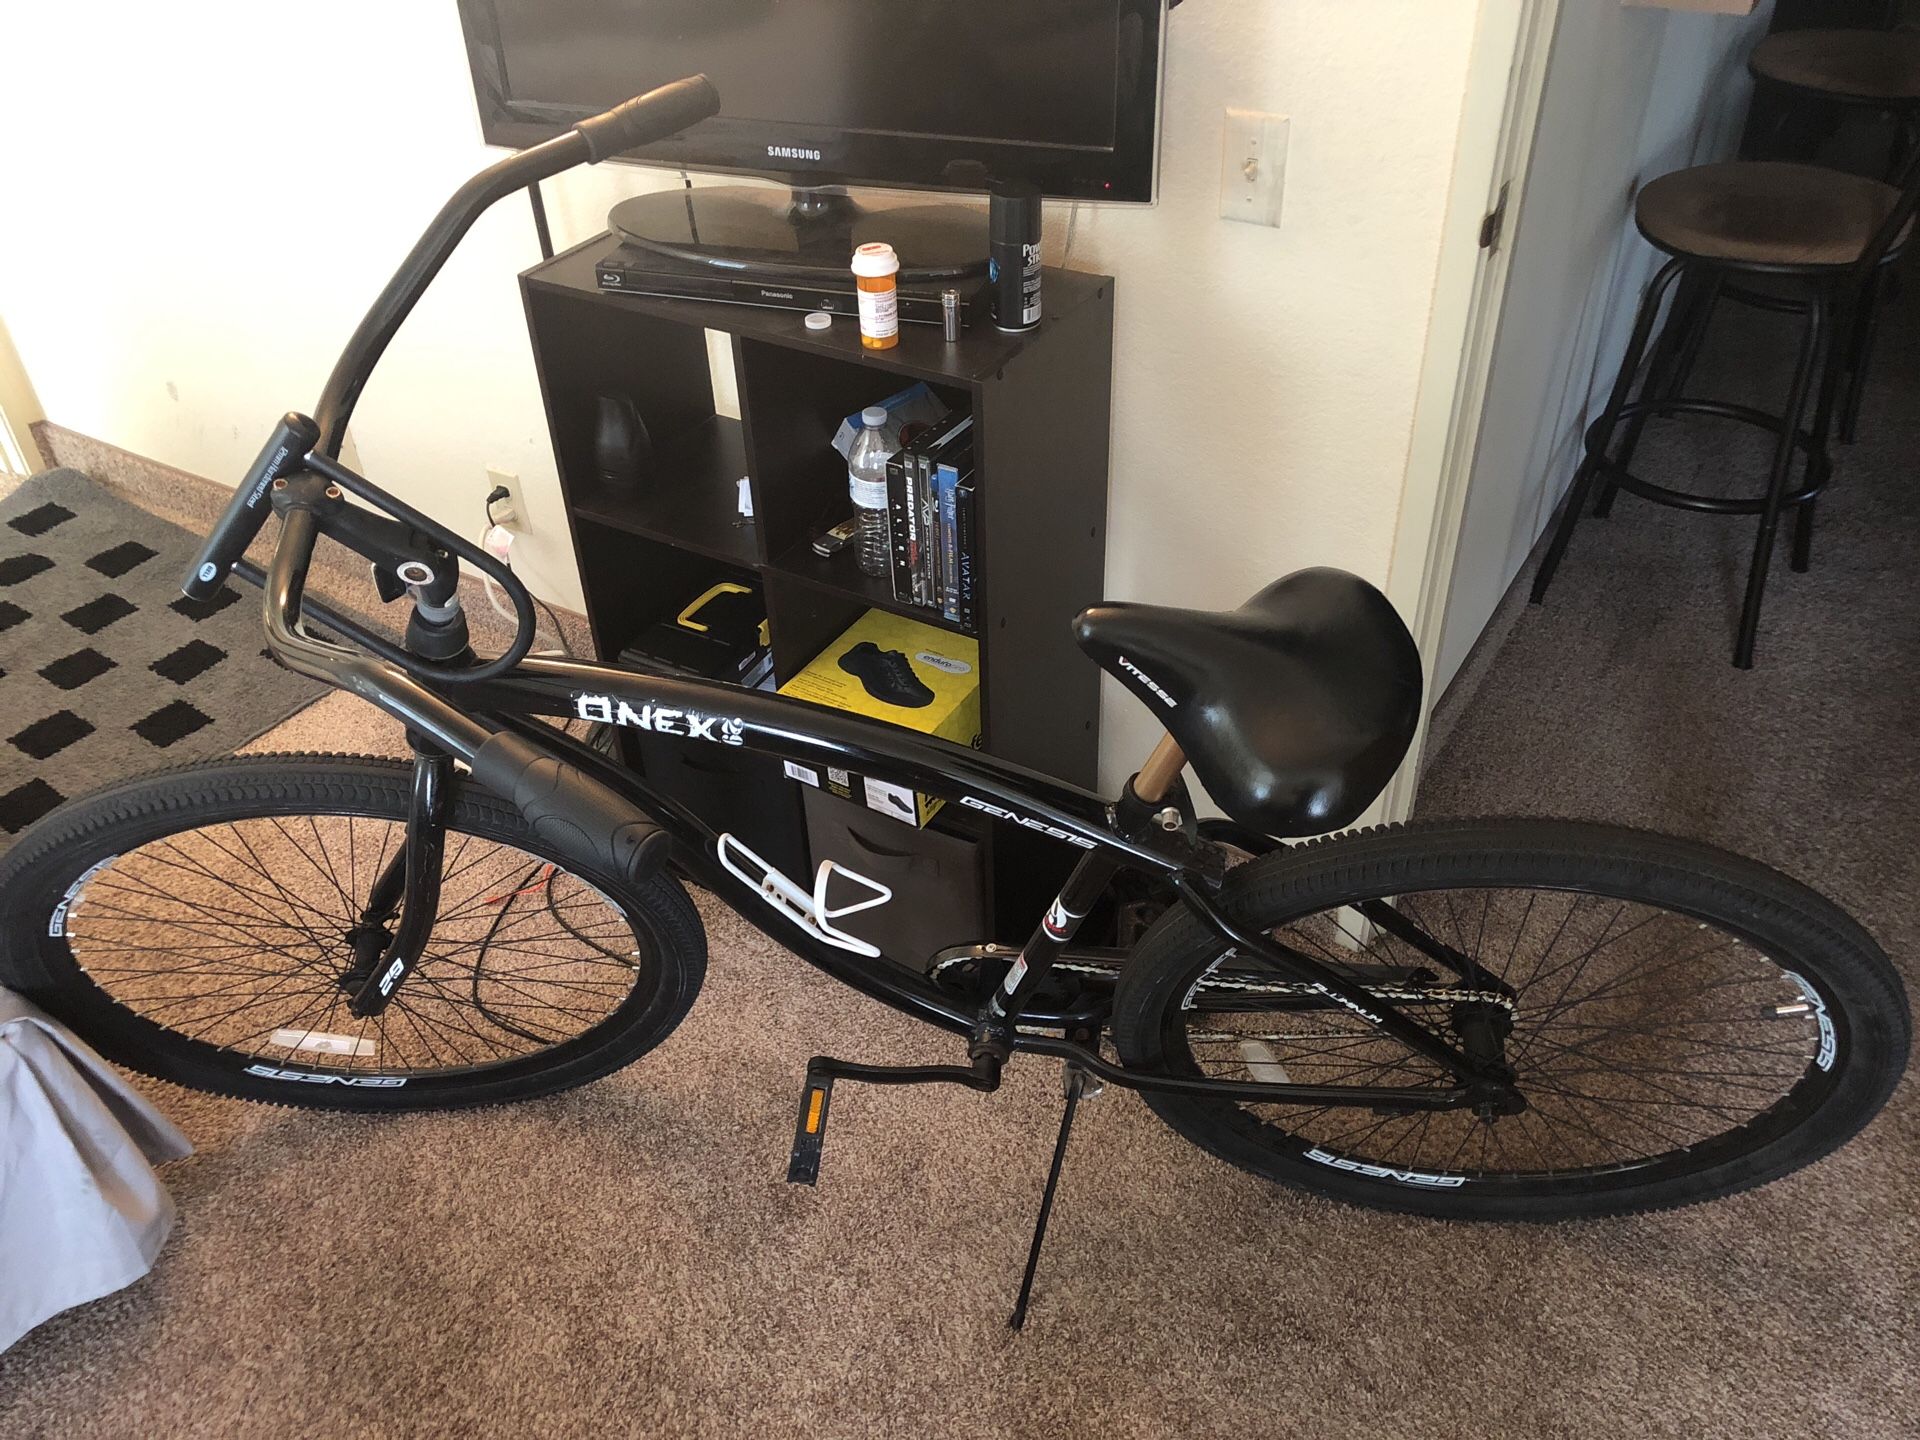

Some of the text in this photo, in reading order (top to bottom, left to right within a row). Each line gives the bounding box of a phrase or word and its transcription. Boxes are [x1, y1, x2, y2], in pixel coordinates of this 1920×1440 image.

[767, 145, 821, 161] SAMSUNG
[760, 289, 793, 299] Panasonic
[246, 489, 262, 509] Steel
[906, 476, 916, 541] PREDATOR
[895, 504, 906, 567] ALIEN
[202, 565, 214, 578] BELL
[961, 551, 971, 600] AVATAR
[1118, 655, 1178, 708] VITESSE
[959, 795, 1098, 849] GENESIS
[1311, 982, 1383, 1023] ALUMINUM
[242, 1064, 408, 1088] GENESIS
[1302, 1149, 1467, 1188] GENESIS
